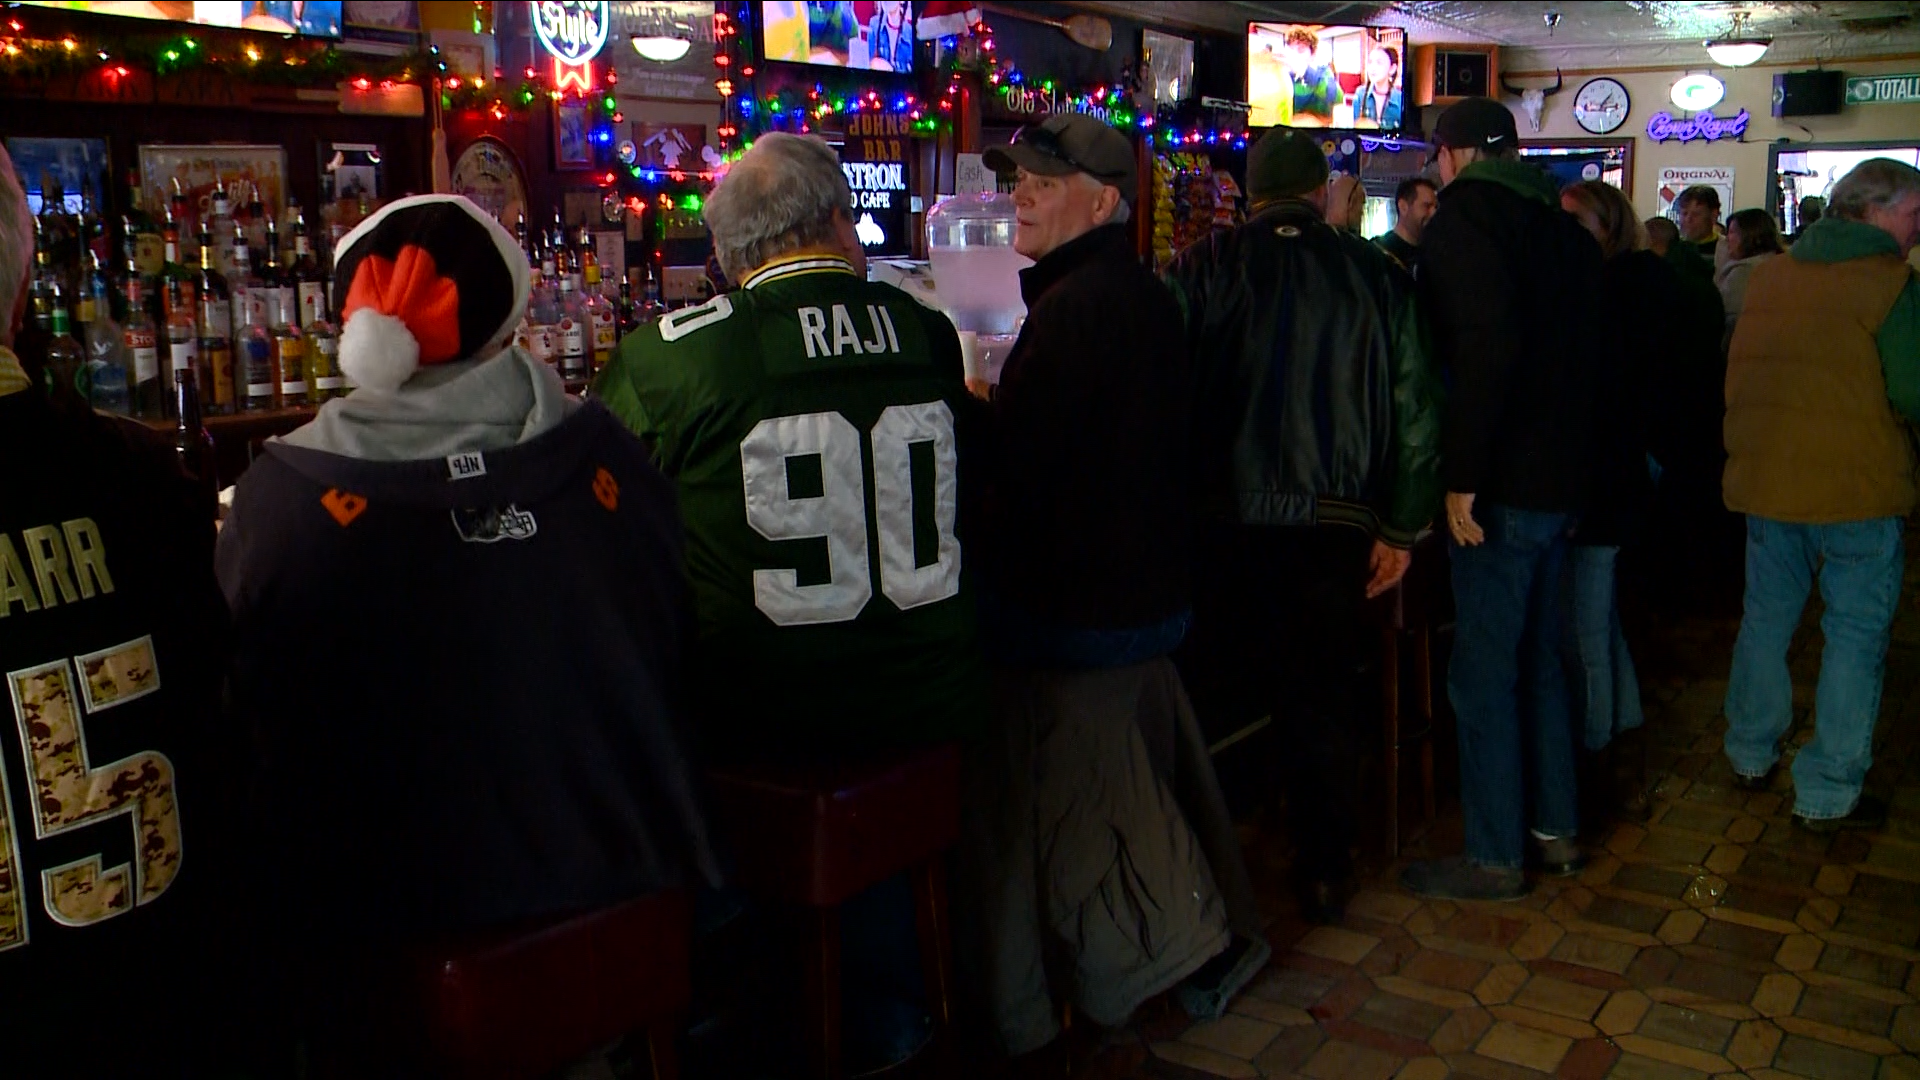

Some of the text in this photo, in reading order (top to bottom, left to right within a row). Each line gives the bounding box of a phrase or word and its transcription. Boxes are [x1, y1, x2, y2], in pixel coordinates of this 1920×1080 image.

[541, 3, 599, 57] Style
[1693, 111, 1749, 140] Royal
[864, 140, 902, 161] BAR
[1664, 169, 1730, 180] ORIGINAL
[798, 304, 900, 359] RAJI
[740, 400, 962, 627] 90
